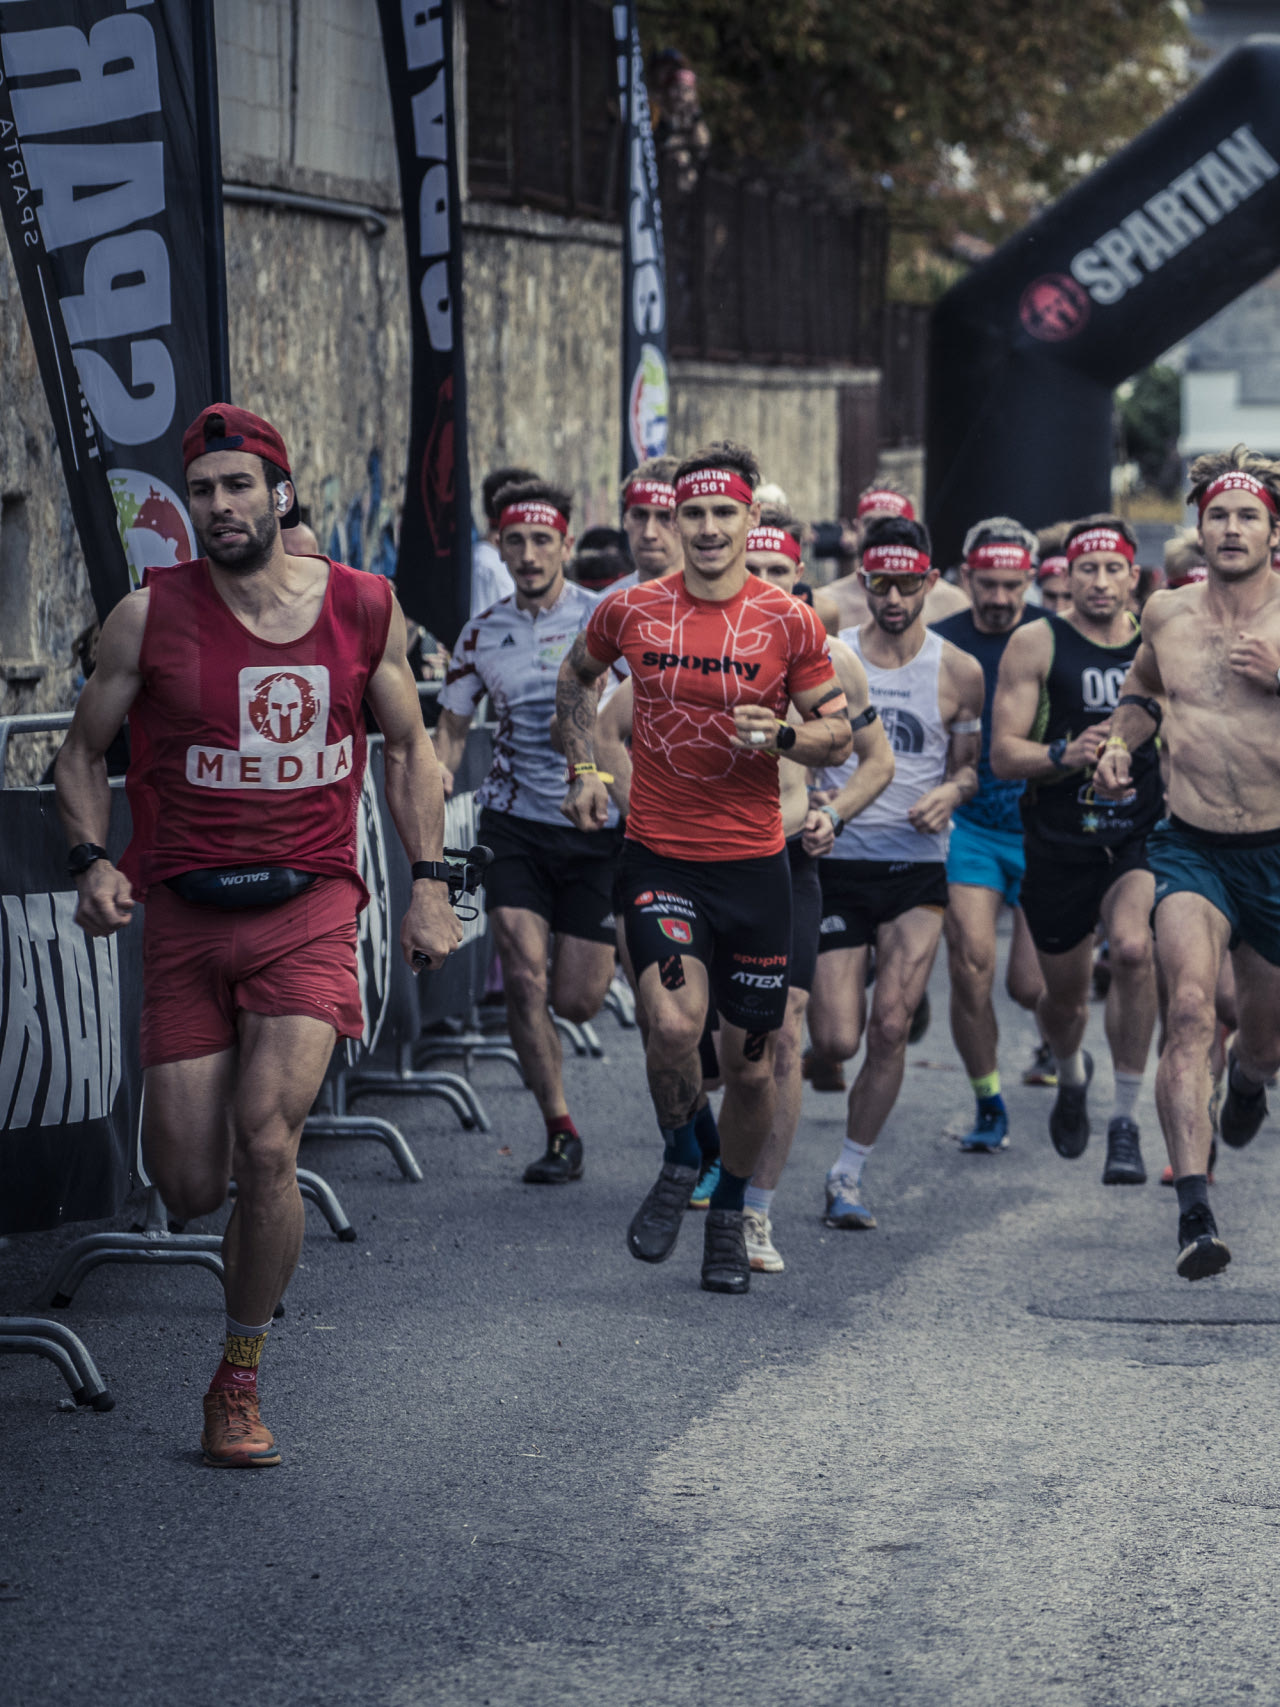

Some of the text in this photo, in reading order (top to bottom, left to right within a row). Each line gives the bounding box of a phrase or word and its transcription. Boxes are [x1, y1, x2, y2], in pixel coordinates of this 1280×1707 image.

[1070, 124, 1280, 306] SPARTAN
[684, 470, 731, 483] SPARTAN
[645, 481, 677, 495] SPAR
[692, 481, 726, 494] 2561
[516, 502, 559, 518] SPARTAN
[747, 539, 781, 551] 2568
[877, 545, 920, 560] SPARTAN
[642, 650, 761, 682] spophy
[1082, 666, 1127, 707] OC
[196, 745, 349, 783] MEDIA
[219, 872, 270, 886] SALOM
[731, 971, 785, 989] ATEX
[0, 890, 121, 1131] RTAN
